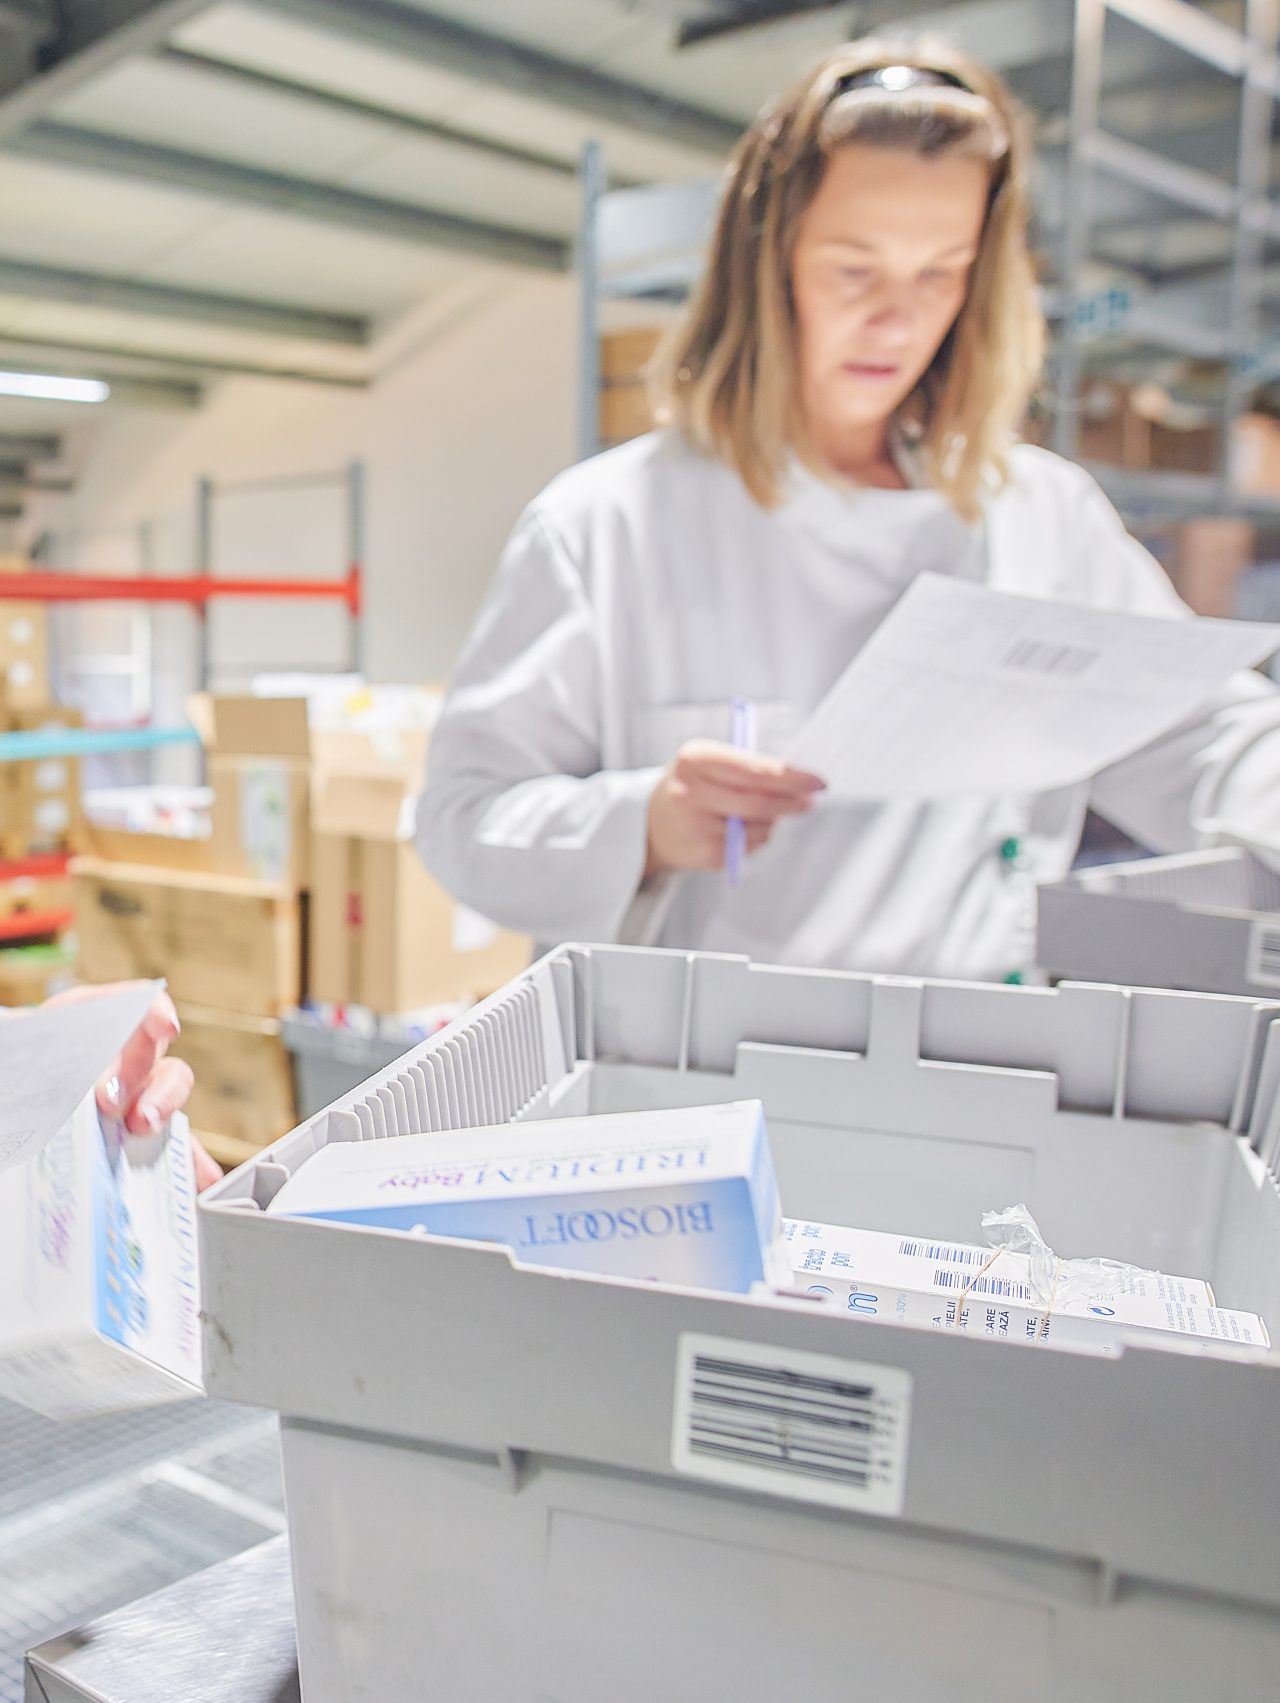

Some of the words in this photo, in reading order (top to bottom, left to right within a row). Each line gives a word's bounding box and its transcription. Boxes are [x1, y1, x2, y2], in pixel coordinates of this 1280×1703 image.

[378, 1172, 464, 1189] Baby
[476, 1151, 708, 1184] IRIDIUM
[946, 1301, 956, 1329] PIELII
[985, 1308, 996, 1336] CARE
